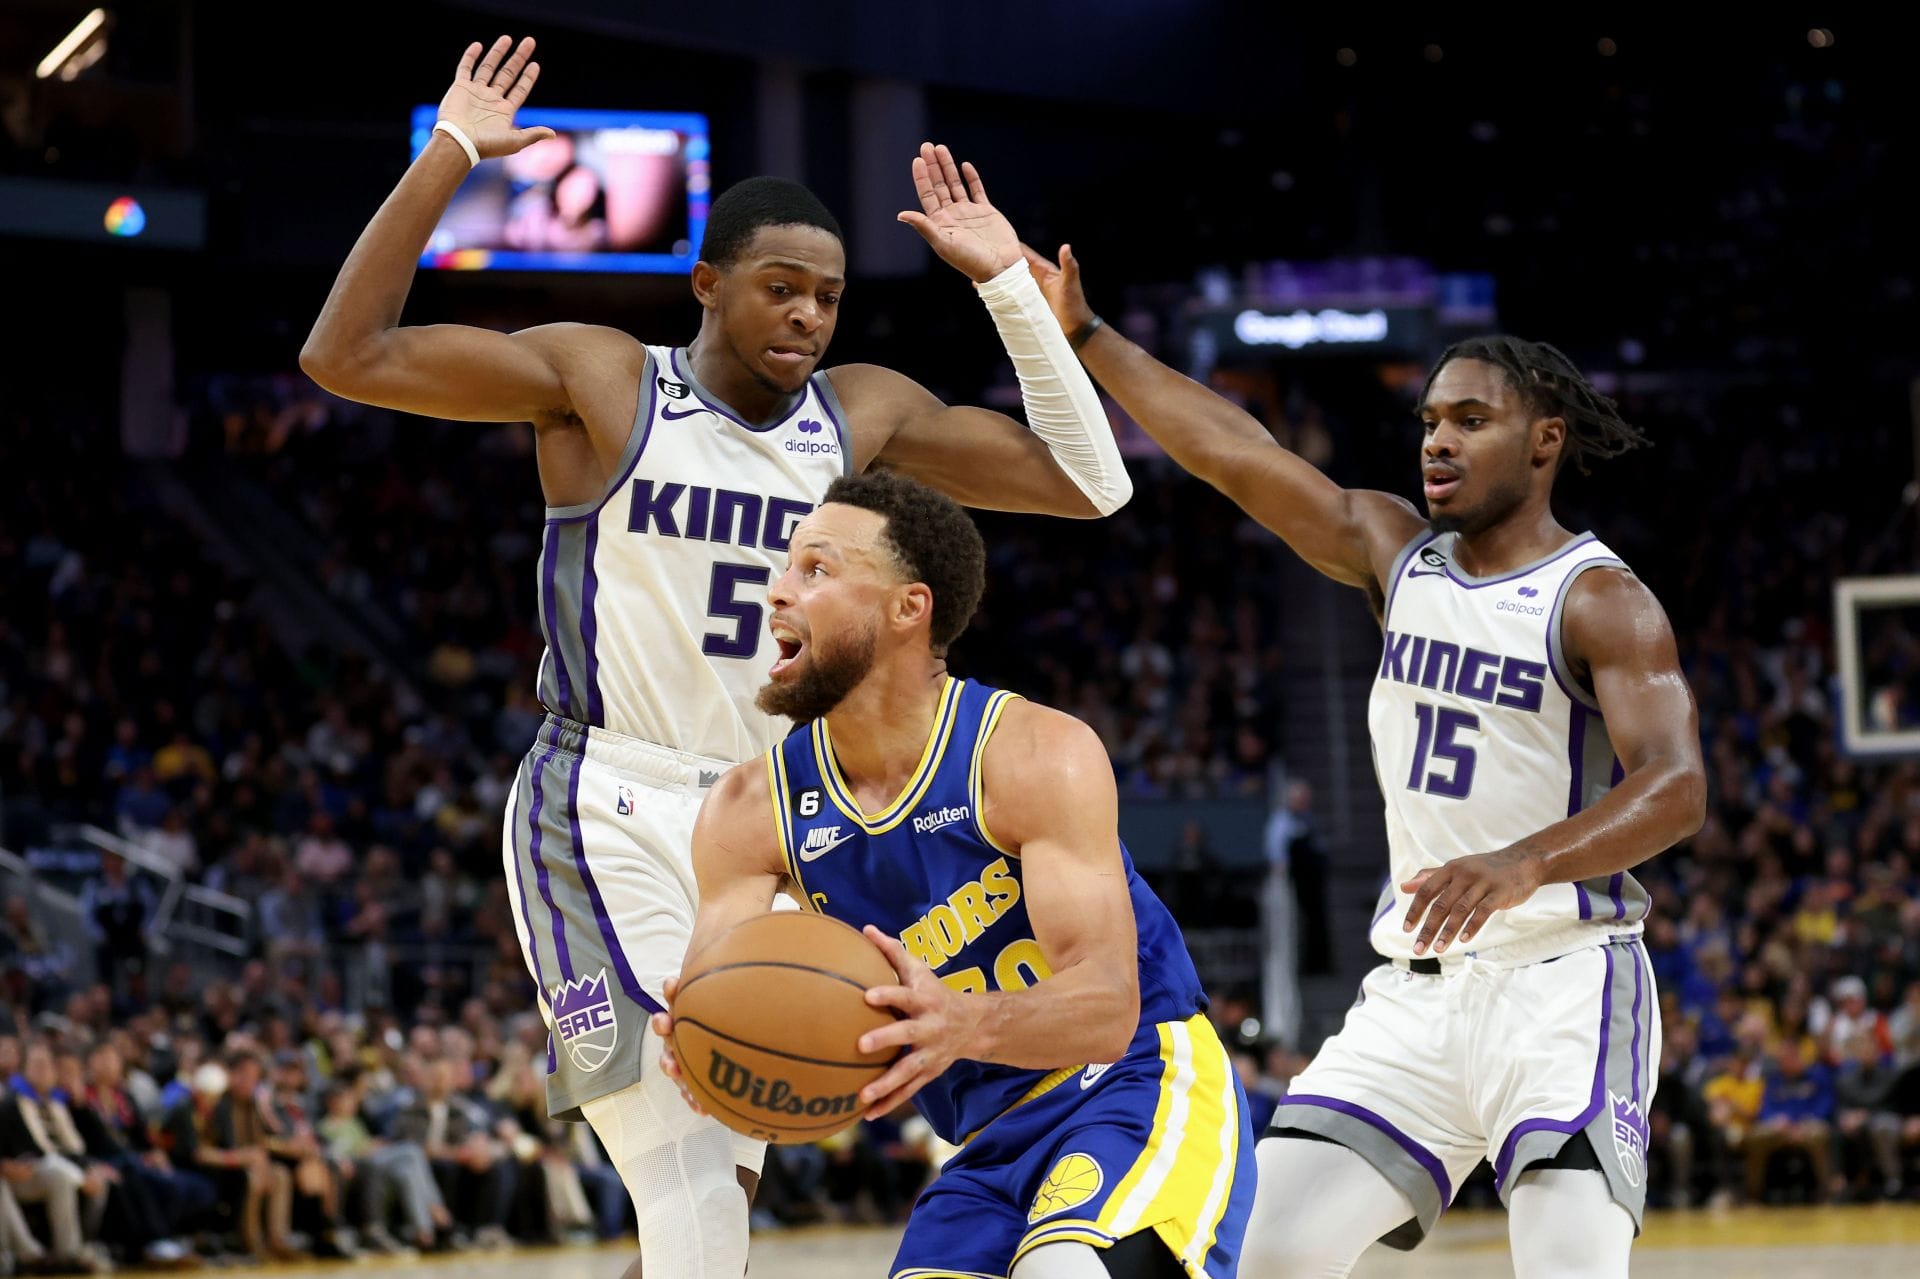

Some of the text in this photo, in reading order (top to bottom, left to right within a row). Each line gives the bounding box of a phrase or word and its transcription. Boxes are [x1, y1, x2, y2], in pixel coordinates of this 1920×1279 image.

[627, 478, 822, 553] KING
[701, 560, 771, 660] 5
[1496, 600, 1545, 616] dialpad
[1380, 630, 1548, 714] KINGS
[1406, 701, 1480, 800] 15
[799, 790, 820, 816] 6
[912, 805, 970, 834] Rakuten
[805, 826, 841, 849] NIKE
[558, 1003, 614, 1041] SAC
[709, 1048, 859, 1117] Wilson
[1615, 1121, 1642, 1158] SA
